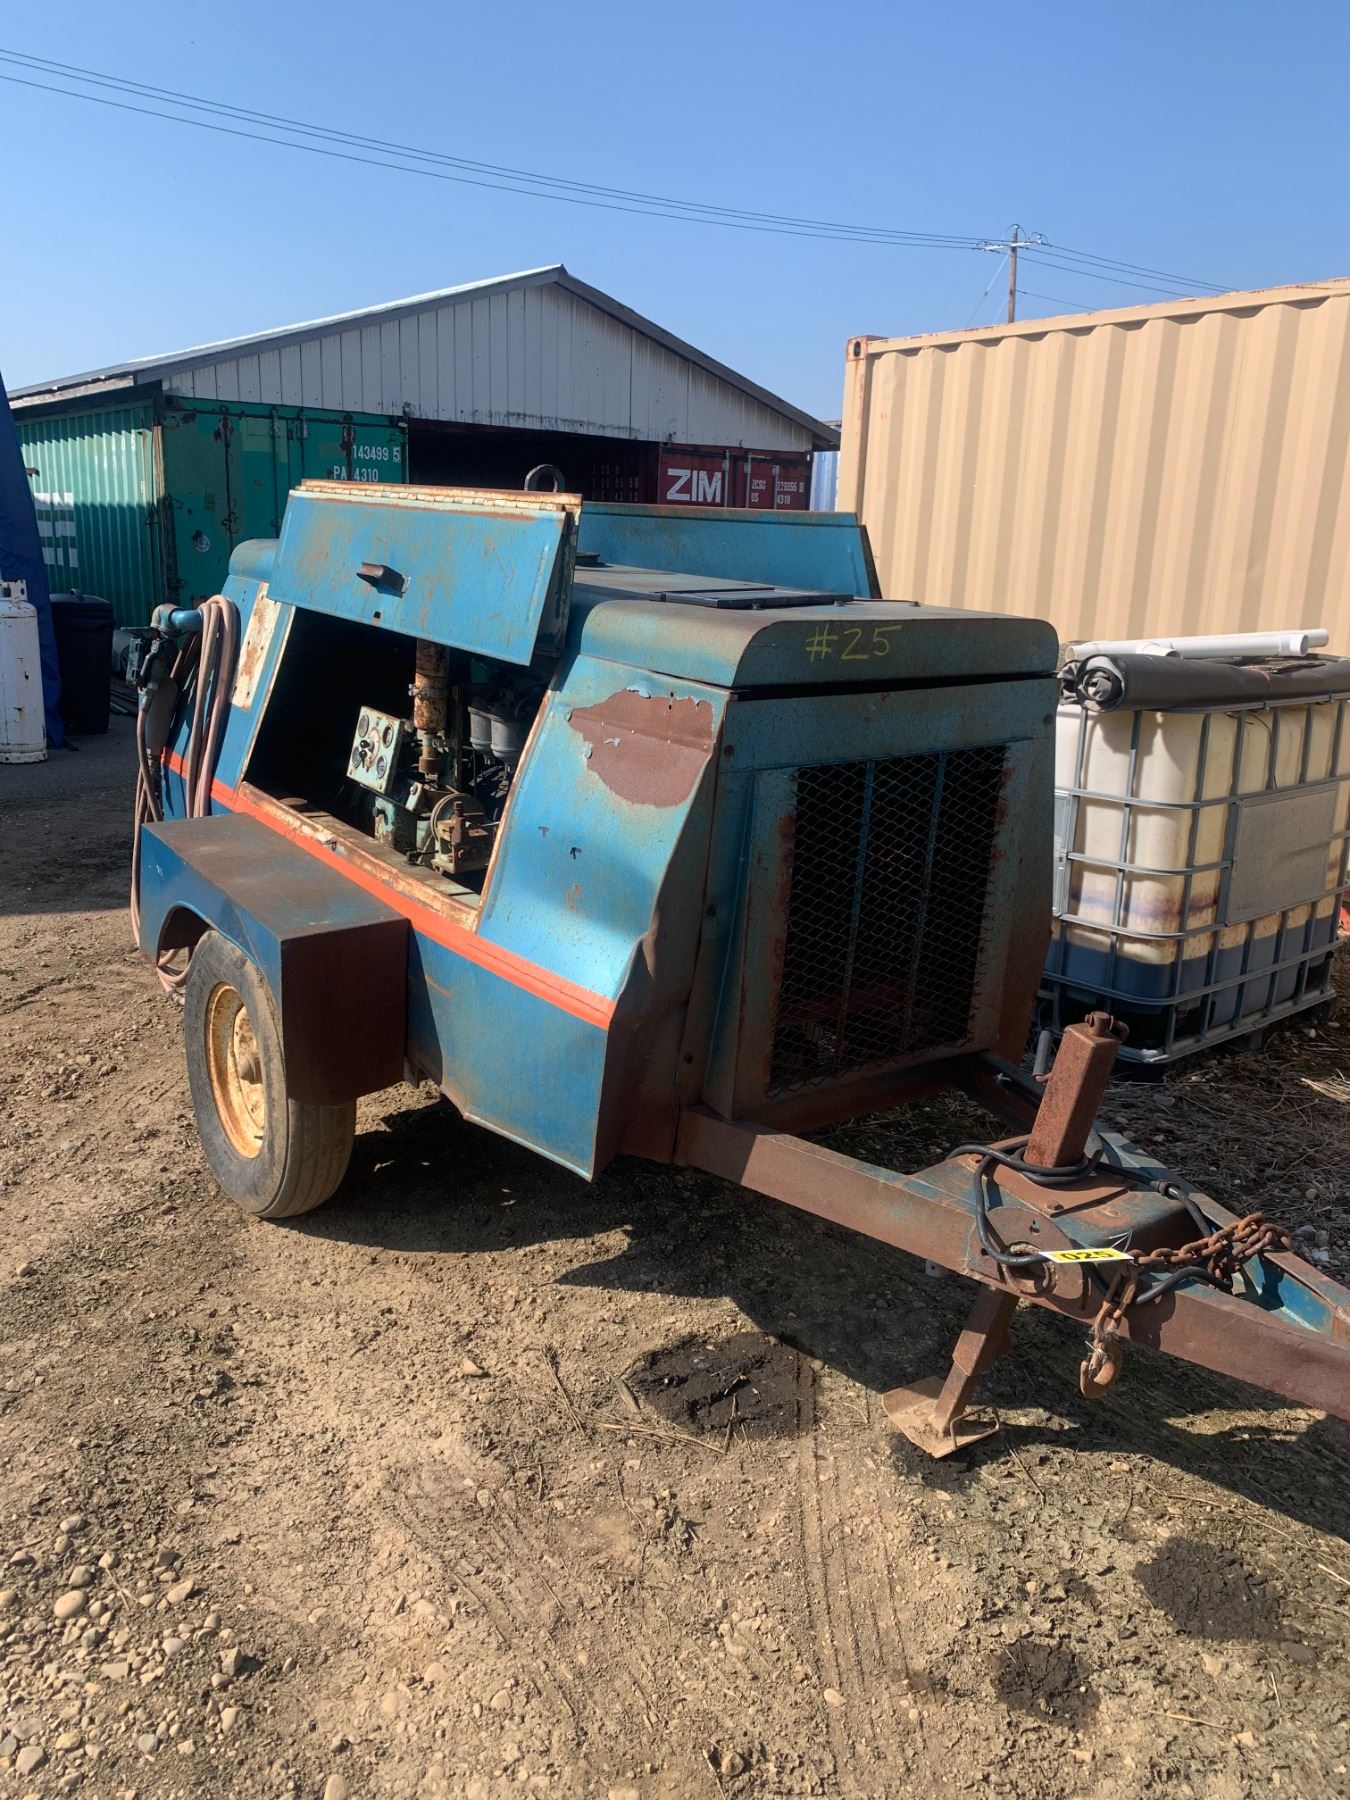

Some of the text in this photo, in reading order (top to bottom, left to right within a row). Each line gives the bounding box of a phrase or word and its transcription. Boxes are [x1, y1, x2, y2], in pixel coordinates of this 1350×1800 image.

[352, 444, 389, 462] 143499
[333, 465, 379, 482] PA 4310
[666, 468, 722, 504] ZIM
[805, 623, 902, 662] #25
[1060, 1250, 1114, 1260] 025
